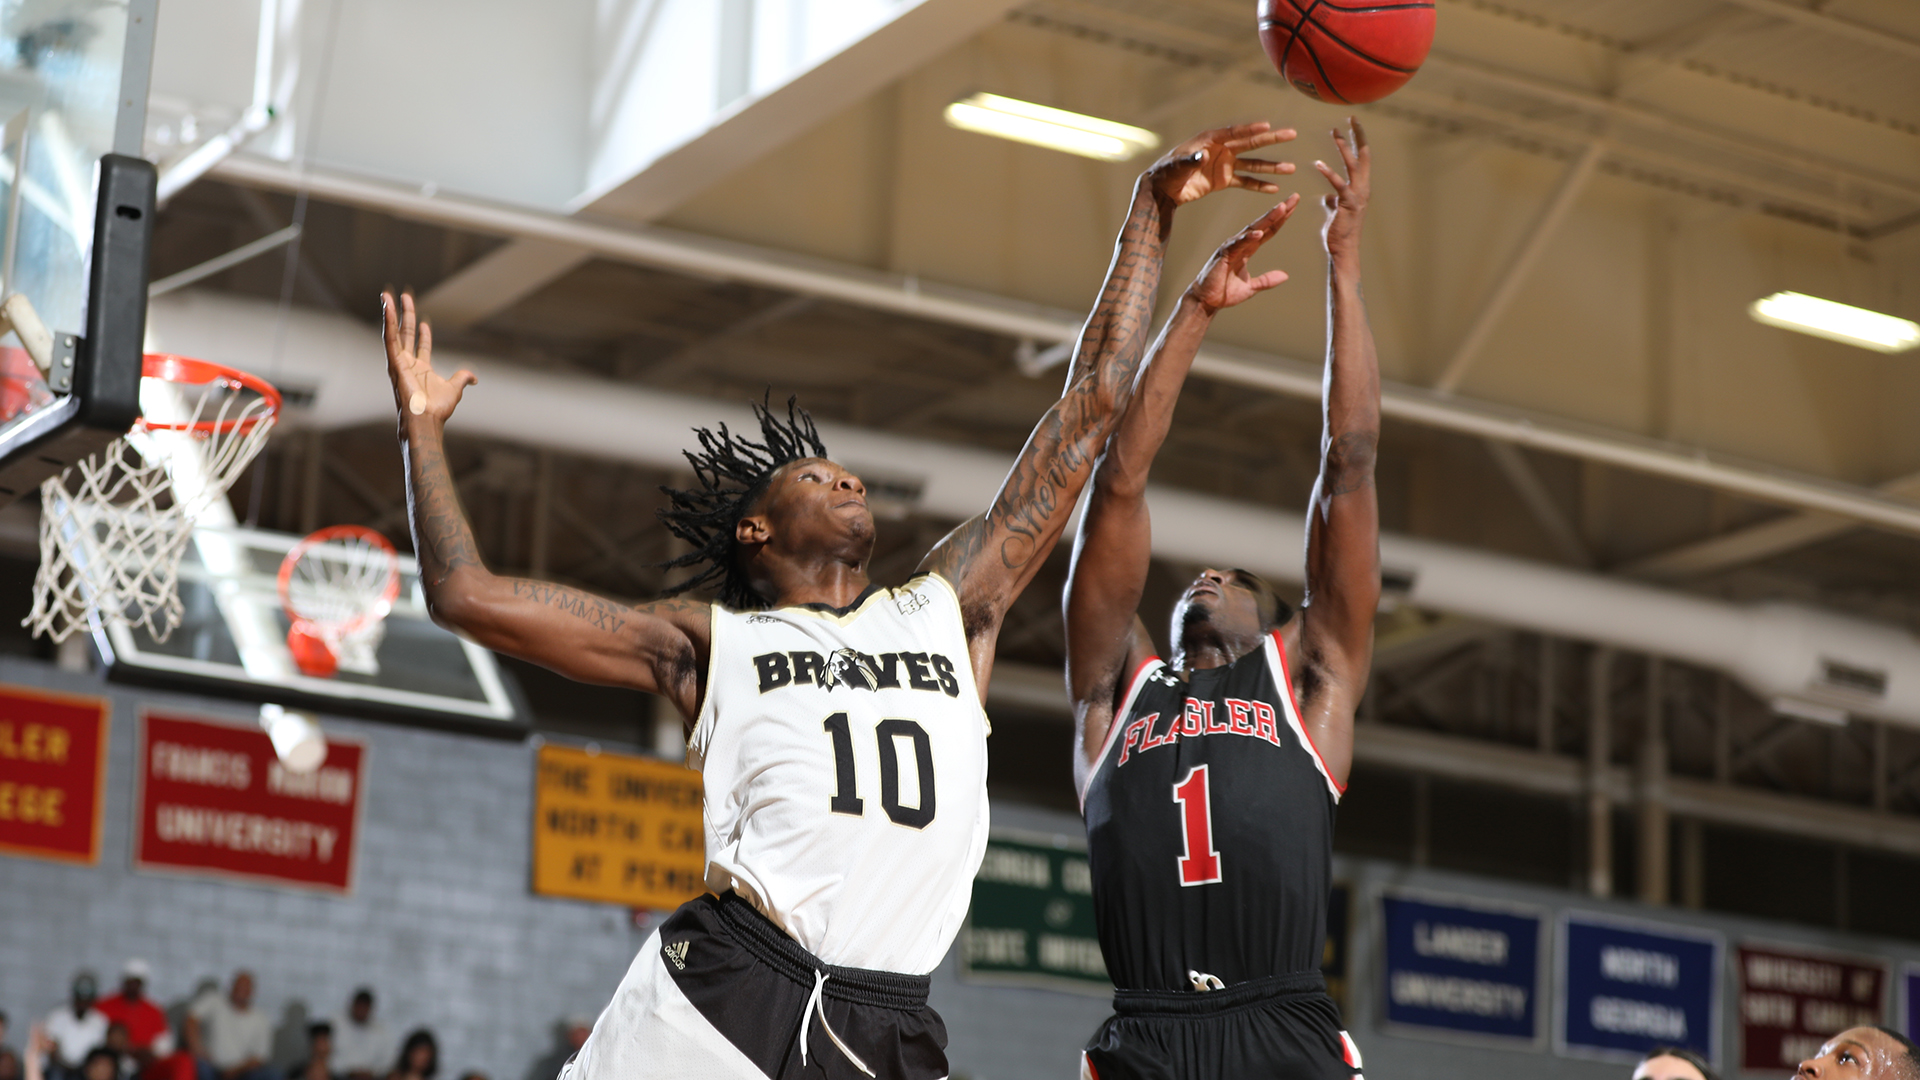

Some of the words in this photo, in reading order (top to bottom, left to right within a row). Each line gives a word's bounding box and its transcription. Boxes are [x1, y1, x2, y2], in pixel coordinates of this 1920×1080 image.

[753, 649, 959, 699] BRVES
[1118, 697, 1281, 767] FLAGLER
[822, 710, 937, 831] 10
[157, 804, 339, 863] UNIVERSITY
[547, 807, 641, 842] NORTH
[1173, 763, 1222, 887] 1
[570, 852, 602, 881] AT
[664, 945, 686, 970] adidas
[1413, 920, 1509, 966] LANDER
[1602, 944, 1679, 989] NORTH
[1391, 970, 1527, 1020] UNIVERSITY
[1590, 995, 1688, 1041] GEORGIA
